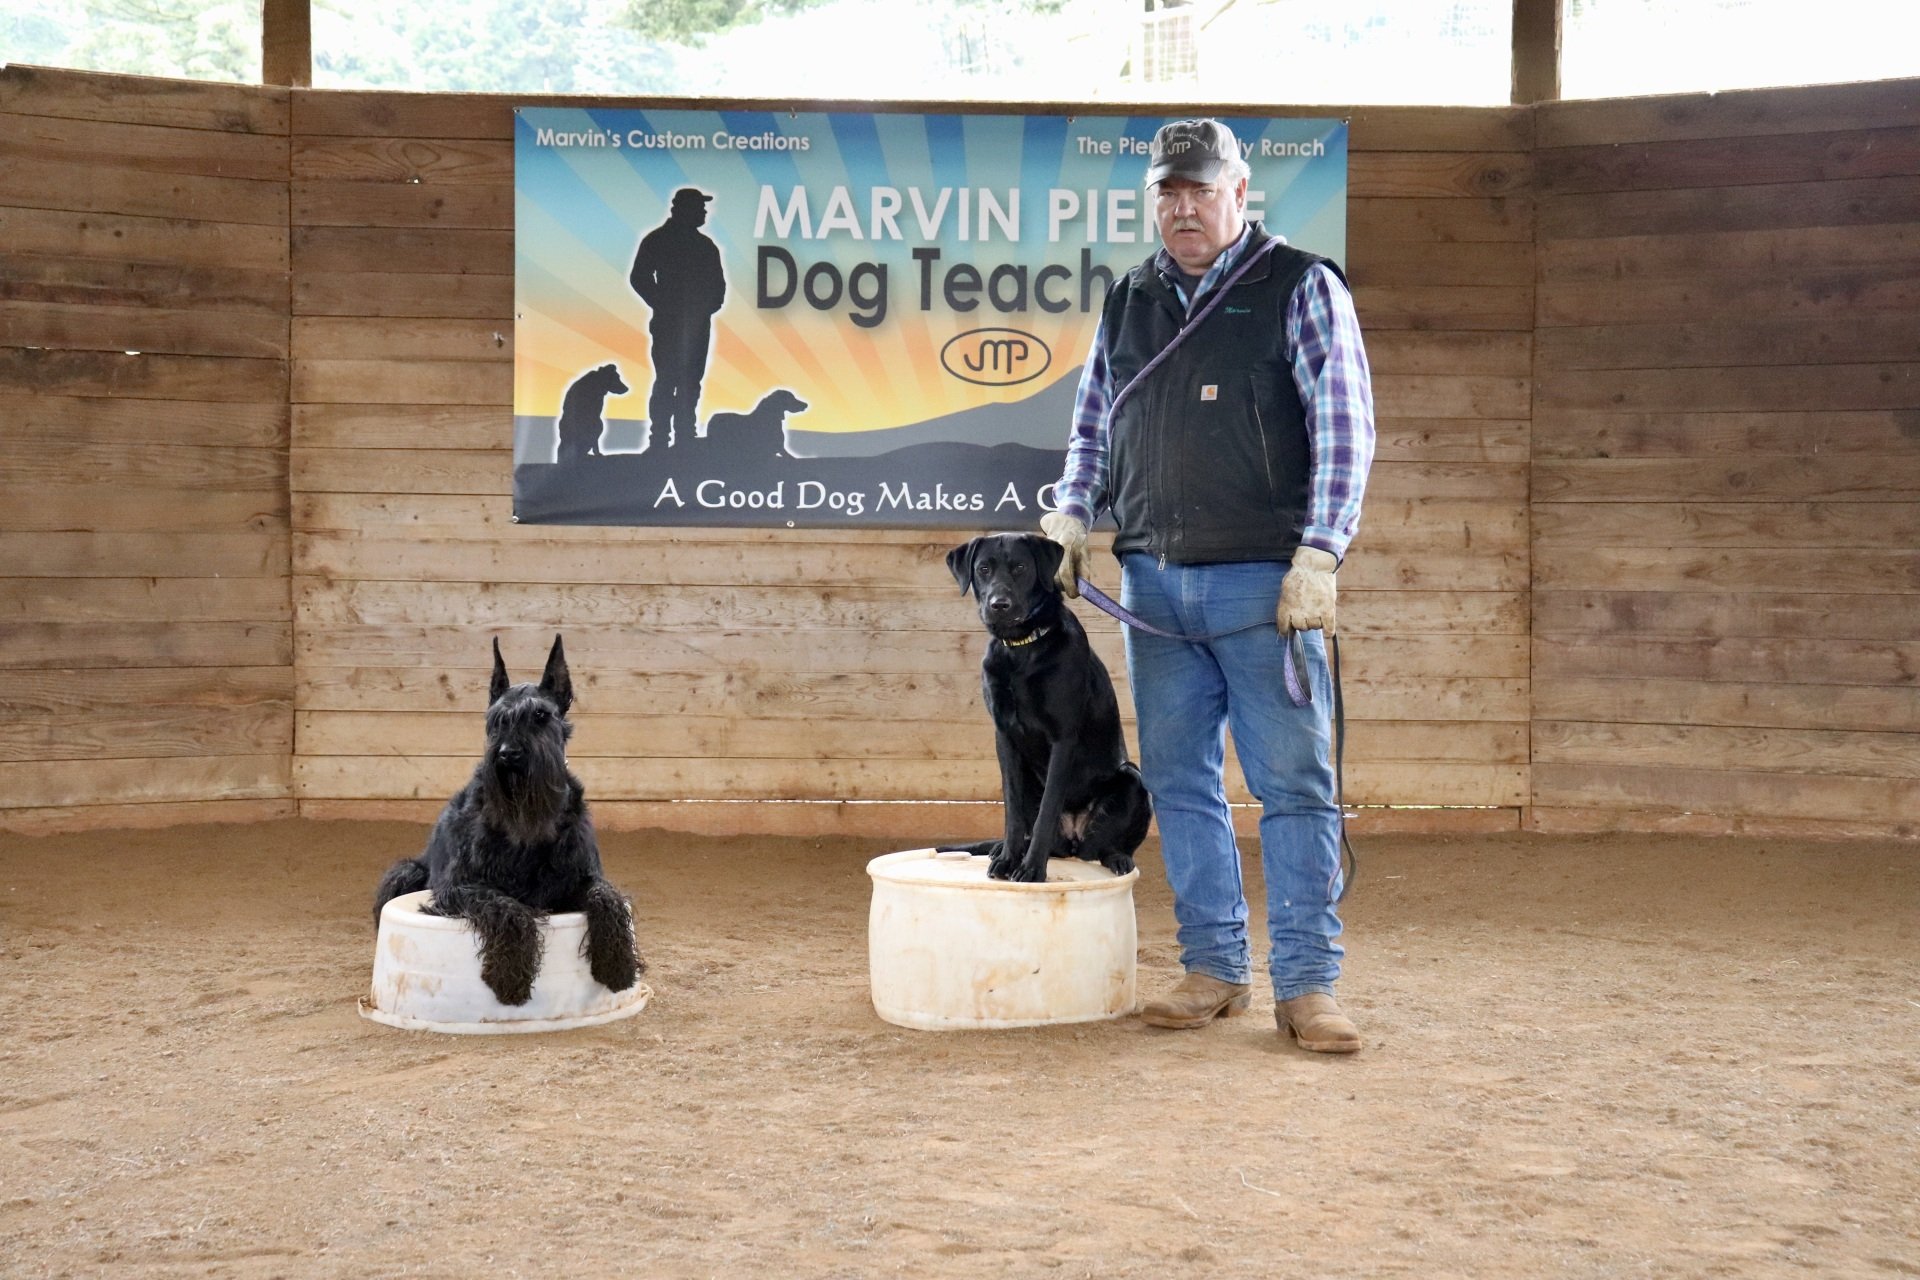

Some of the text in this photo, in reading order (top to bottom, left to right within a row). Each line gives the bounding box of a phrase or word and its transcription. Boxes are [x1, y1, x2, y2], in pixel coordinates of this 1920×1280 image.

[535, 128, 811, 152] Marvin's Custom Creations
[1077, 136, 1112, 155] The
[1261, 138, 1325, 157] Ranch
[753, 184, 1020, 242] MARVIN
[757, 245, 1113, 328] Dog Teach
[653, 477, 686, 509] A
[695, 479, 786, 510] Good
[795, 480, 867, 516] Dog
[875, 481, 986, 512] Makes
[994, 481, 1027, 512] A
